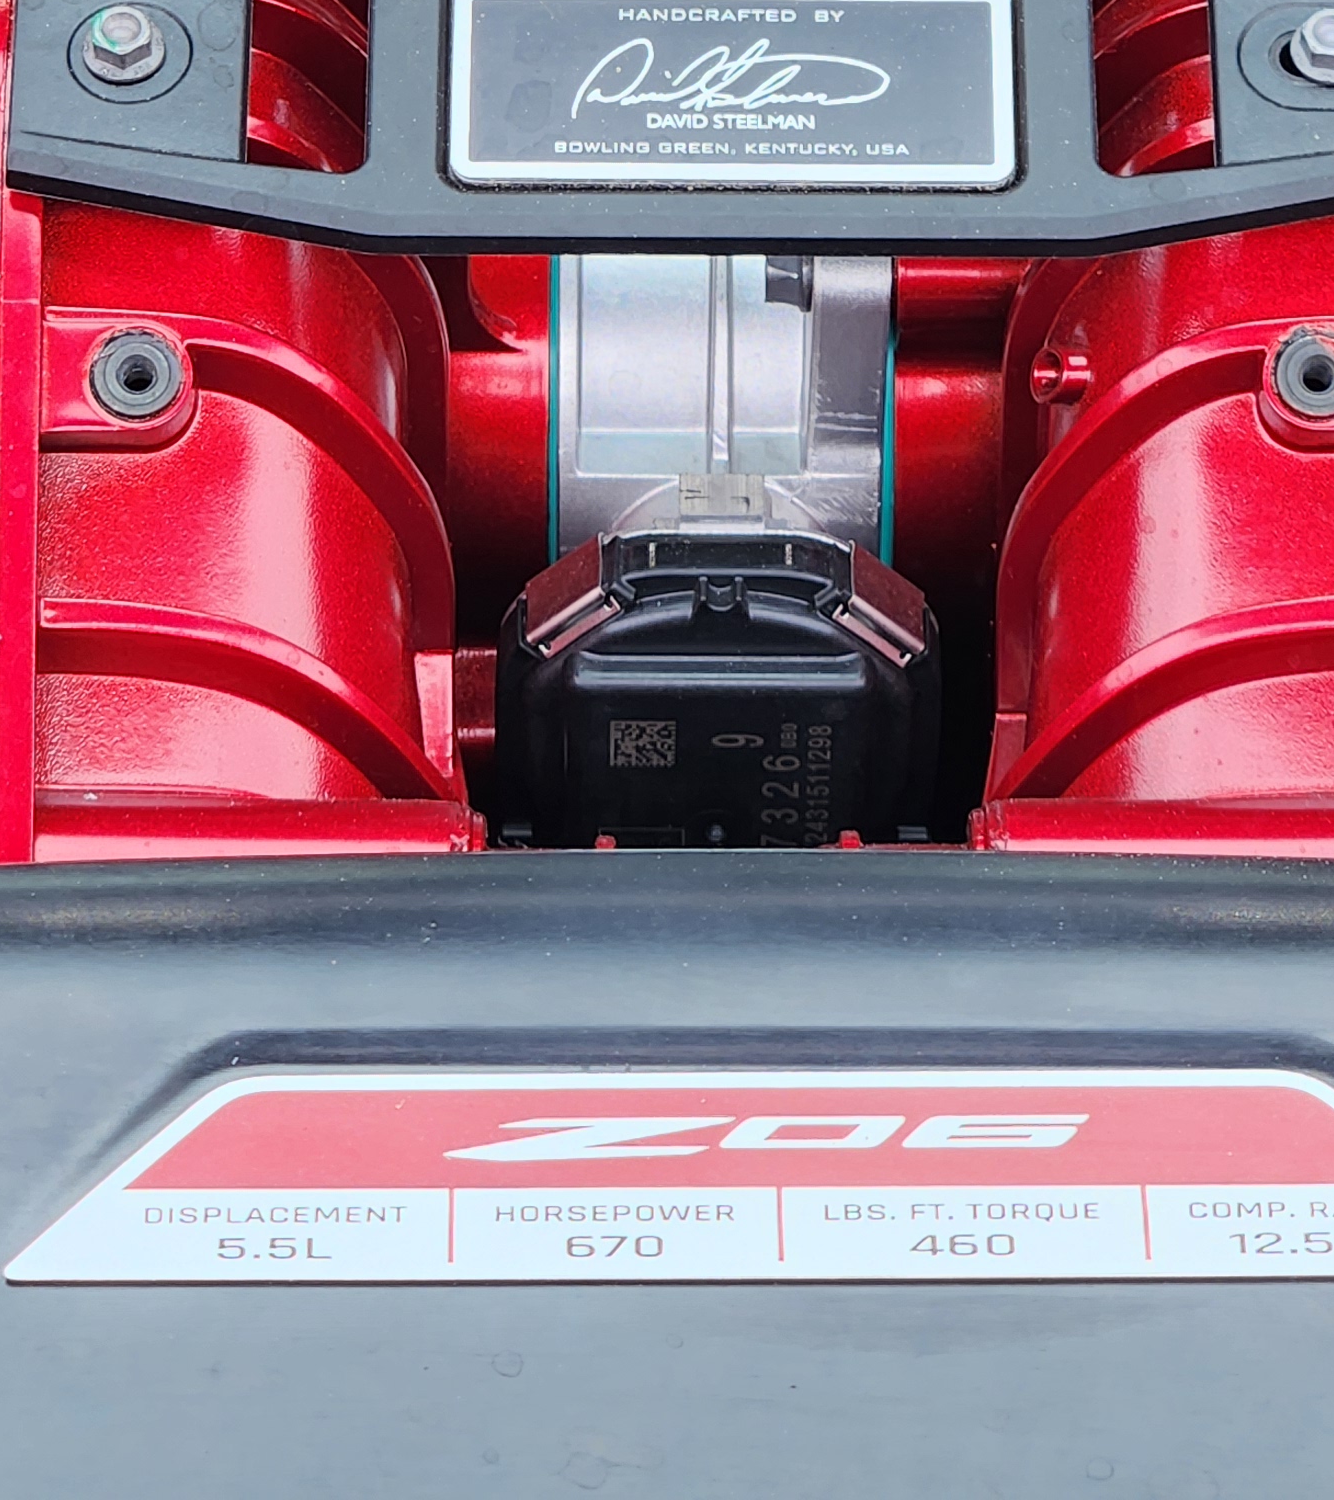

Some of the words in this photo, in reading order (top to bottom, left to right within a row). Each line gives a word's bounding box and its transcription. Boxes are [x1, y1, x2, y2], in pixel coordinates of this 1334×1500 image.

[618, 7, 797, 23] HANDCRAFTED
[814, 9, 845, 23] BY
[646, 112, 709, 129] DAVID
[712, 113, 816, 130] STEELMAN
[554, 141, 650, 154] BOWLING
[658, 142, 736, 155] GREEN,
[745, 142, 858, 157] KENTUCKY,
[866, 143, 910, 156] USA
[711, 734, 764, 748] 9
[443, 1113, 1090, 1162] Z06
[144, 1205, 407, 1224] DISPLACEMENT
[495, 1204, 735, 1222] HORSEPOWER
[824, 1203, 896, 1221] LBS.
[910, 1203, 954, 1221] FT.
[967, 1202, 1099, 1222] TORQUE
[1188, 1201, 1295, 1219] COMP.
[217, 1237, 332, 1260] 5.5L
[566, 1235, 663, 1258] 670
[909, 1233, 1015, 1256] 460
